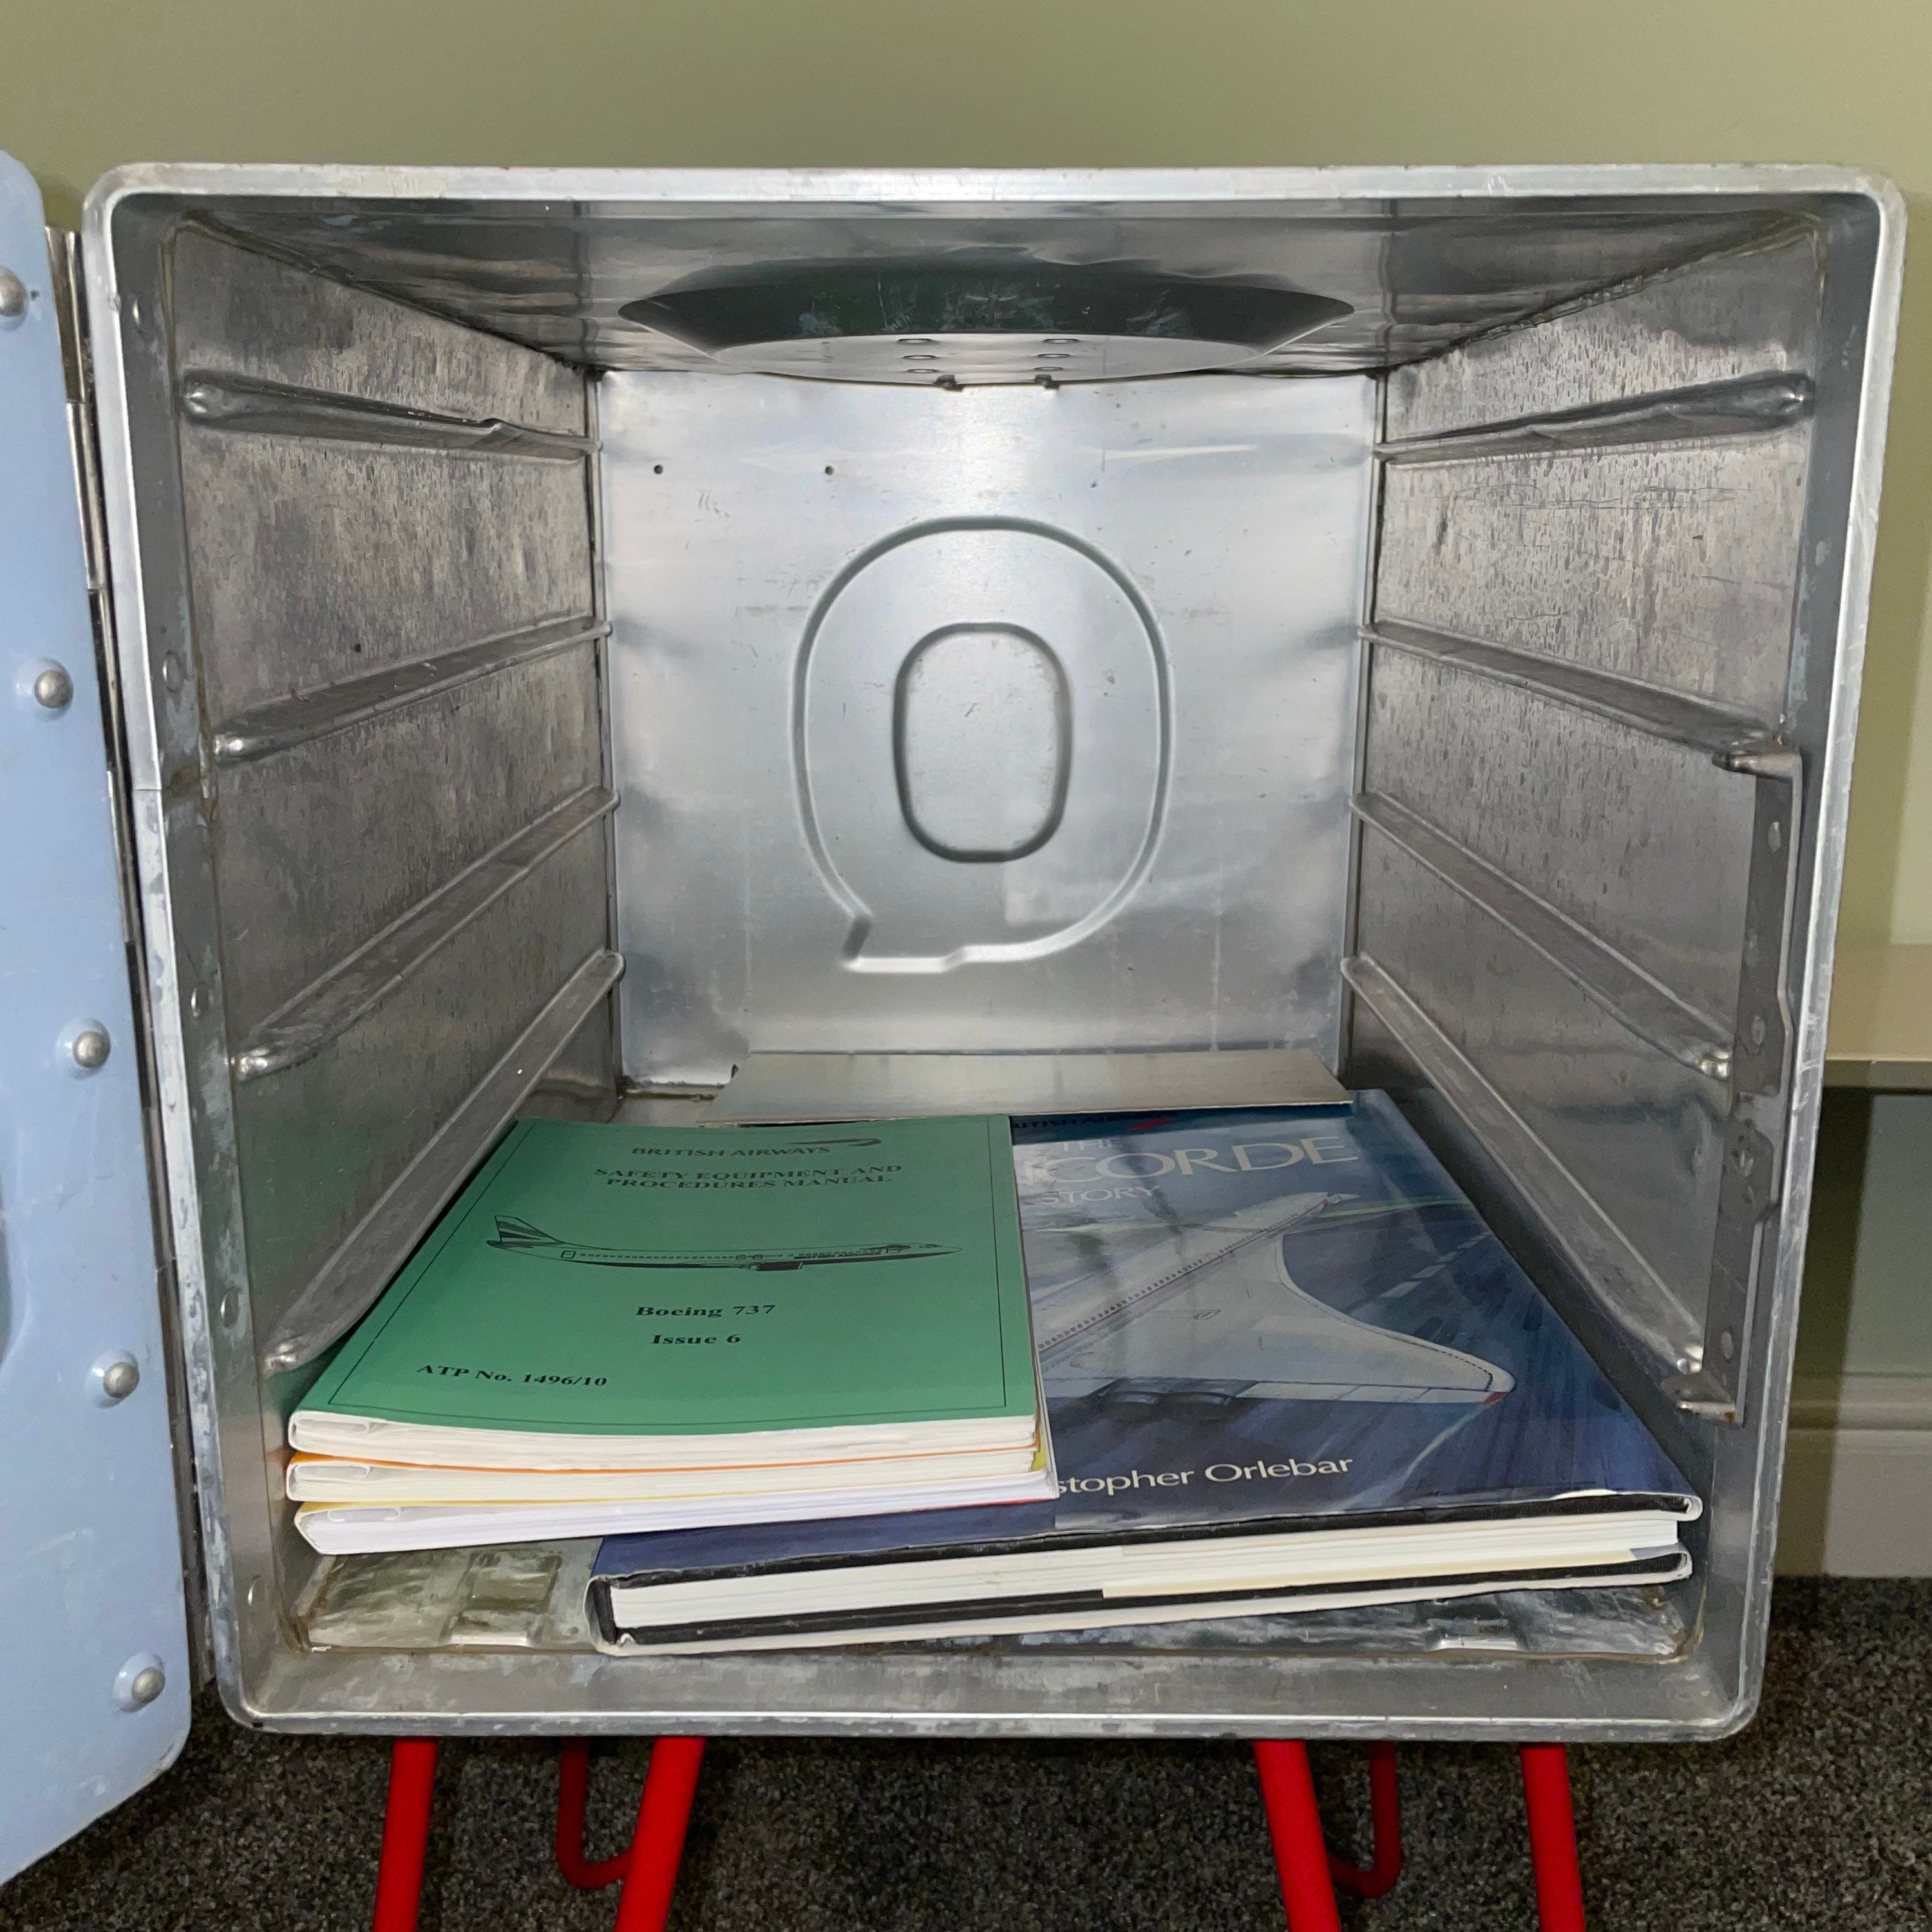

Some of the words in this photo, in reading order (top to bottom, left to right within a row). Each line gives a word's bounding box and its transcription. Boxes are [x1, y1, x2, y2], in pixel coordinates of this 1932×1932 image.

[631, 1147, 724, 1157] BRITISH
[728, 1146, 831, 1157] AIRWAYS
[594, 1168, 692, 1179] SAFETY
[696, 1168, 848, 1180] EQUIPMENT
[853, 1164, 902, 1175] AND
[607, 1178, 776, 1189] PROCEDURES
[783, 1174, 892, 1188] MANUAL
[1038, 1184, 1160, 1205] STORY
[635, 1306, 724, 1318] Boeing
[732, 1304, 776, 1315] 737
[650, 1334, 717, 1345] Issue
[726, 1333, 741, 1344] 6
[416, 1365, 470, 1377] ATP
[474, 1370, 513, 1382] No.
[522, 1374, 608, 1387] 1496/10
[1205, 1458, 1353, 1482] Orlebar
